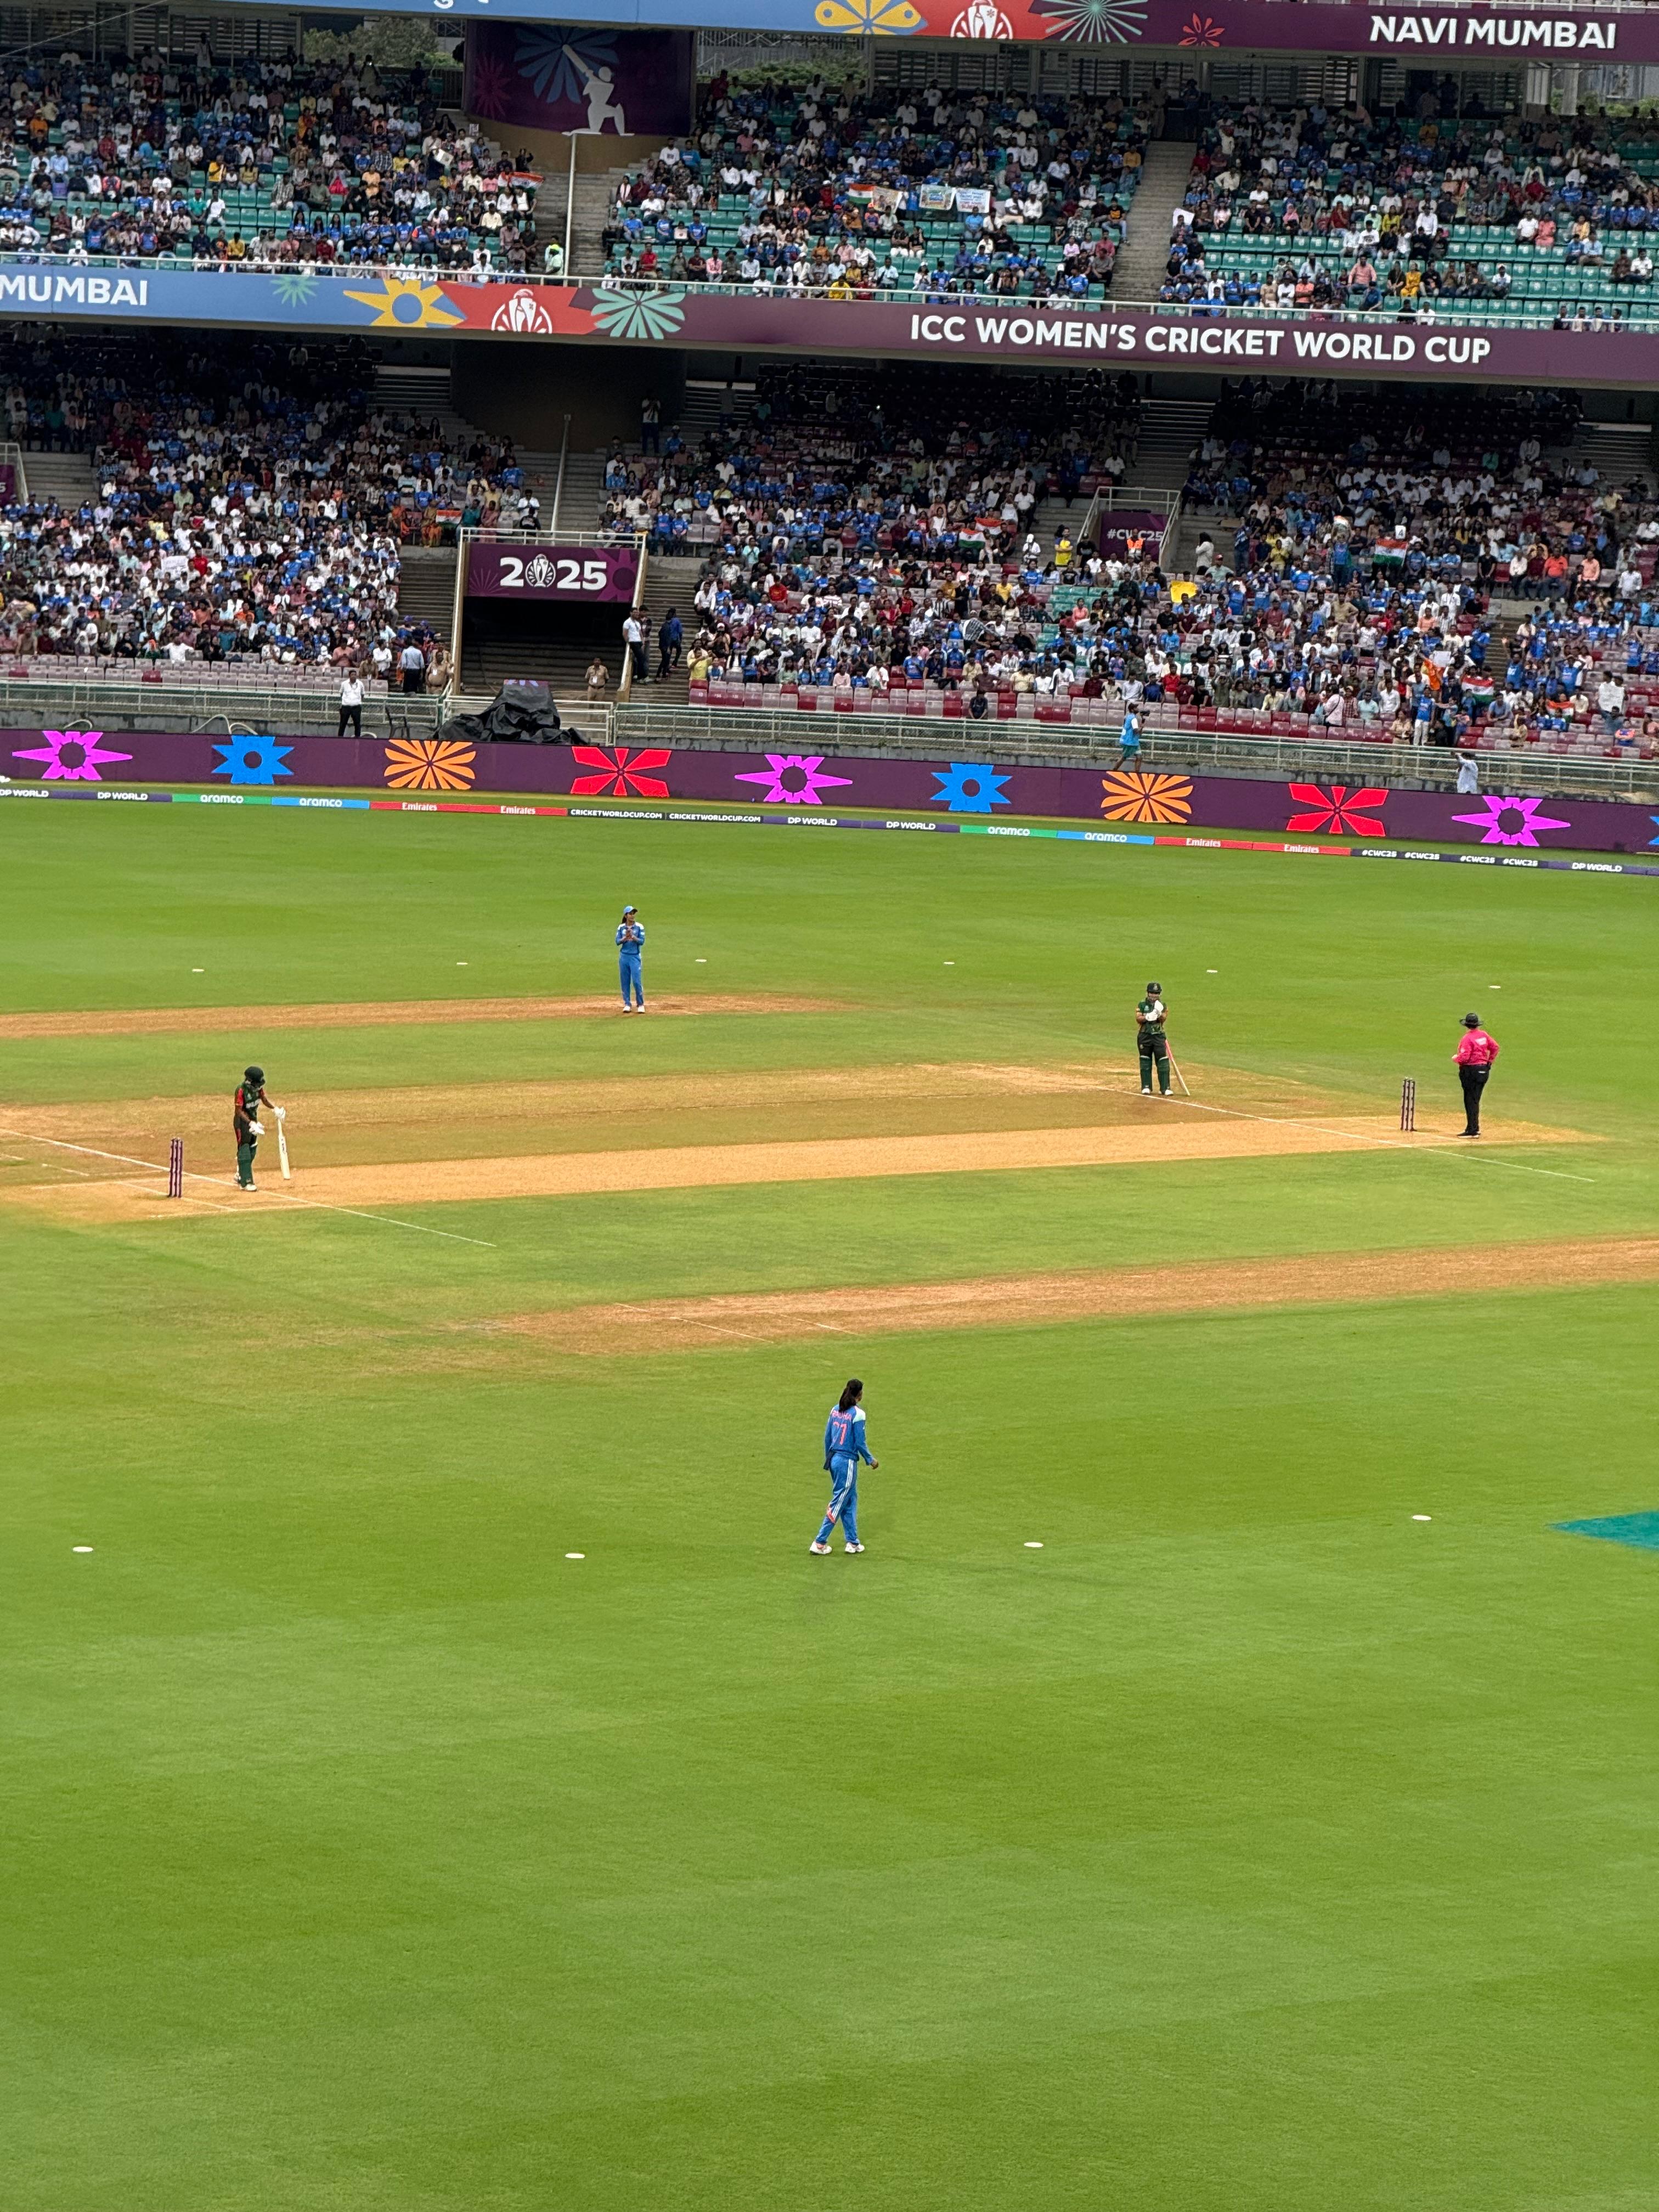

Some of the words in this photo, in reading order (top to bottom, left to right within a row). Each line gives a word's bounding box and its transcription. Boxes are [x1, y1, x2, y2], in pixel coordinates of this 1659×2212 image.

[1370, 15, 1457, 44] NAVI
[1465, 19, 1616, 49] MUMBAI
[0, 274, 148, 306] MUMBAI
[911, 314, 966, 342] ICC
[975, 317, 1136, 350] WOMEN'S
[1145, 326, 1285, 356] CRICKET
[1293, 331, 1415, 361] WORLD
[1425, 336, 1491, 363] CUP
[13, 789, 49, 798] WORLD
[97, 791, 111, 799] DP
[111, 792, 148, 800] WORLD
[200, 794, 244, 804] aramco
[299, 798, 342, 808] aramco
[402, 802, 438, 811] Emirates
[500, 805, 536, 815] Emirates
[571, 809, 662, 819] CRICKETWORLDCUP.COM
[669, 813, 761, 822] CRICKETWORLDCUP.COM
[802, 817, 838, 826] WORLD
[900, 822, 936, 830] WORLD
[988, 826, 1031, 837] aramco
[1085, 832, 1127, 843] aramco
[1186, 838, 1221, 848] Emirates
[1284, 844, 1319, 854] Emirates
[1362, 849, 1397, 857] #CWC25
[1404, 852, 1440, 860] #CWC25
[1460, 855, 1495, 864] #CWC25
[1503, 858, 1538, 866] #CWC25
[1587, 863, 1623, 872] WORLD
